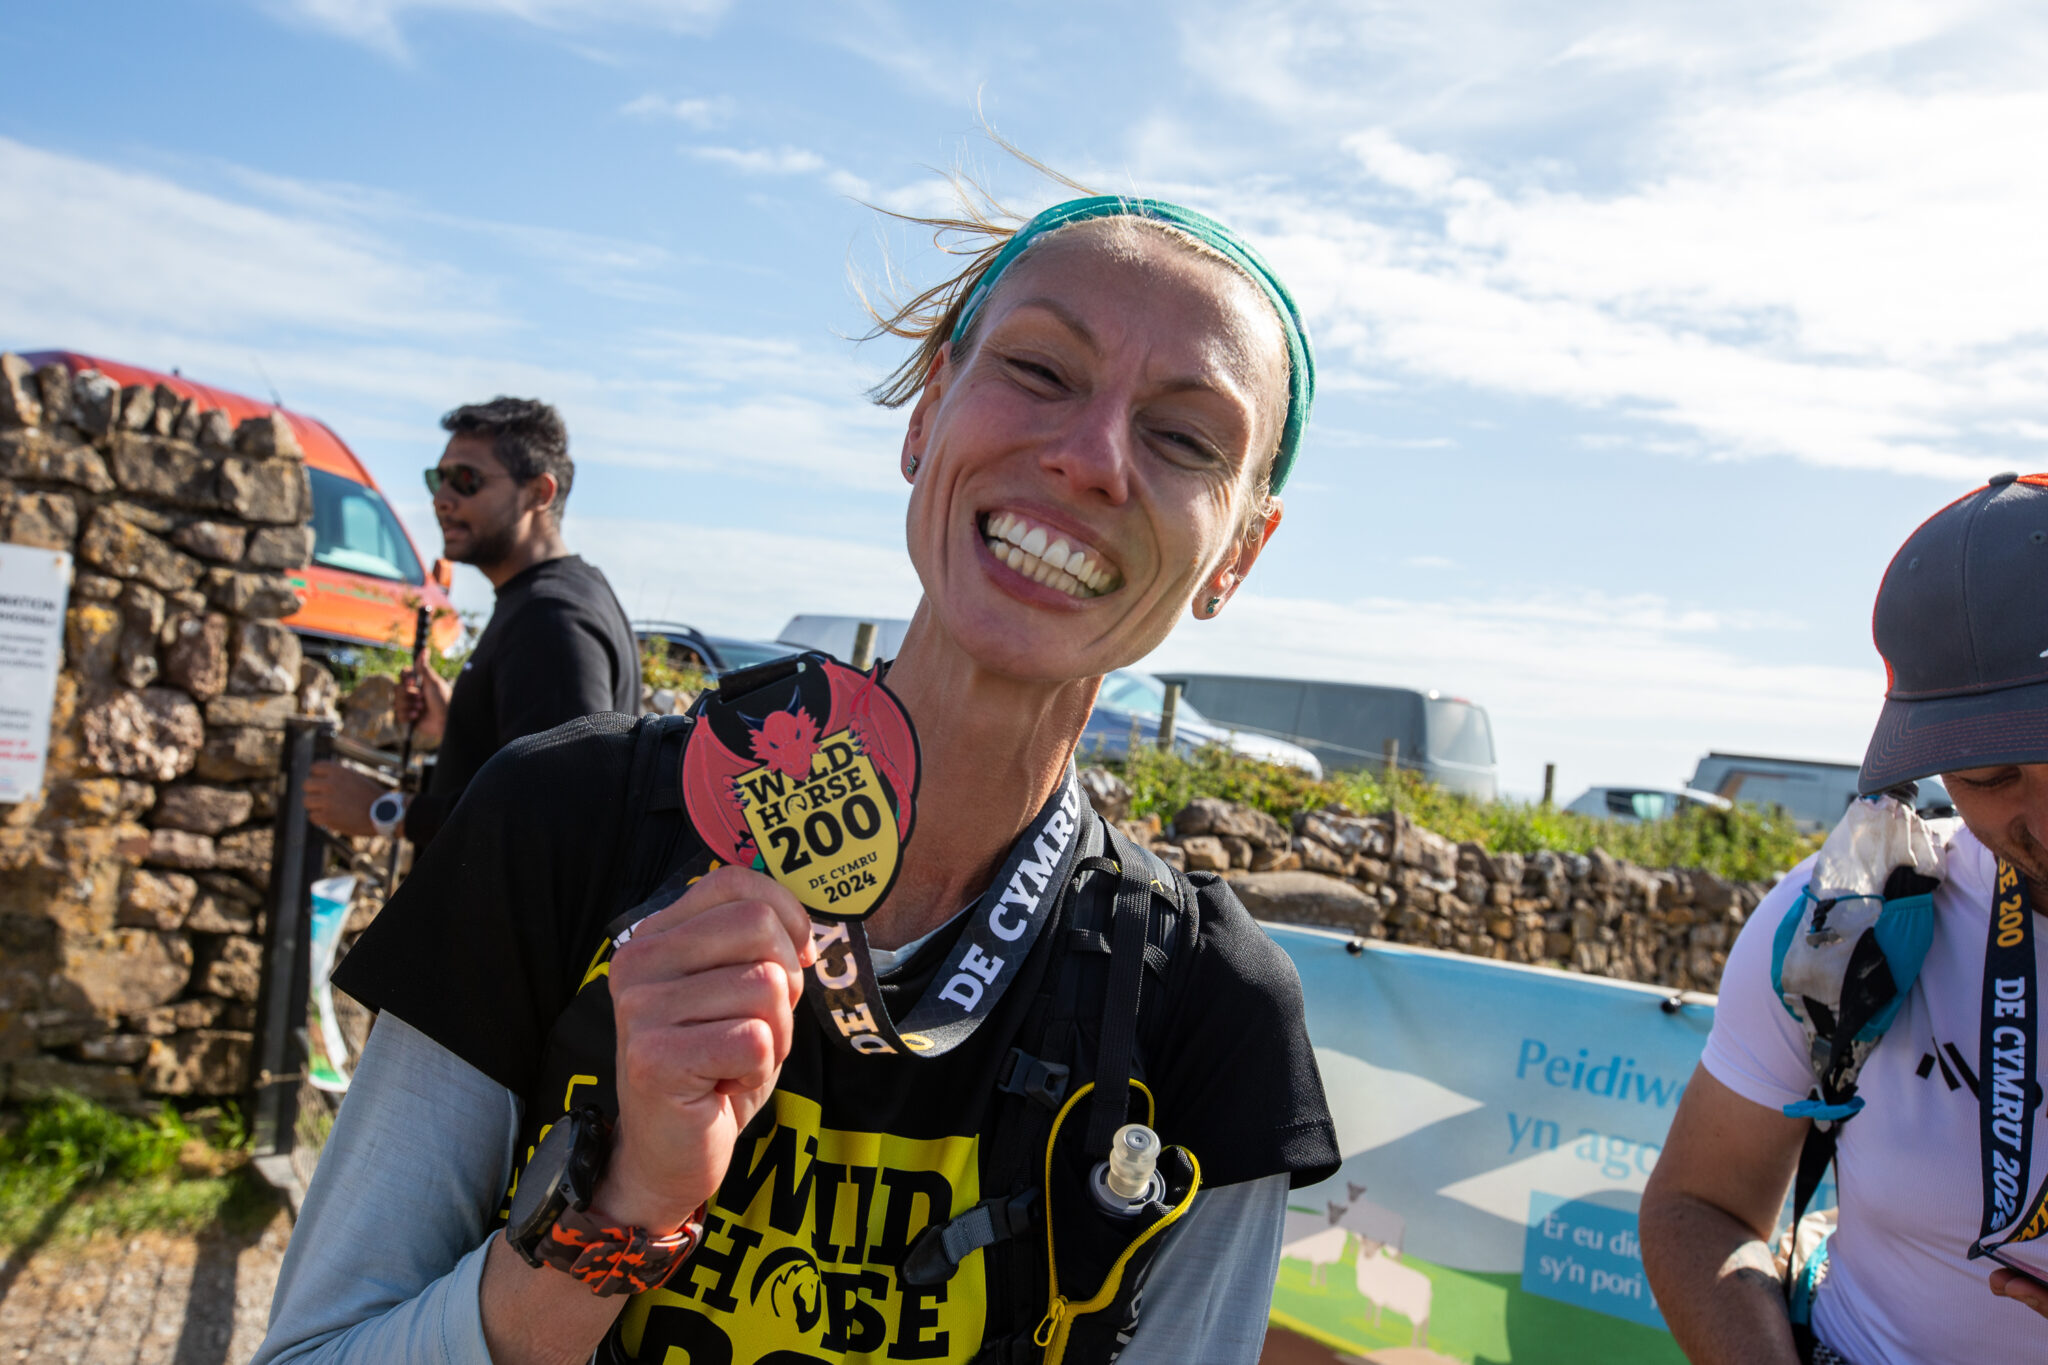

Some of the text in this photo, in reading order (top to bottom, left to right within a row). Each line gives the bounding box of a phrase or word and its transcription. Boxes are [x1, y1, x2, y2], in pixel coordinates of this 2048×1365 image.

[743, 741, 855, 806] WLD
[756, 766, 868, 831] HORSE
[768, 794, 881, 875] 200
[808, 851, 878, 890] DE CYMRU
[823, 870, 878, 905] 2024
[938, 774, 1080, 1013] DE CYMRU
[1996, 893, 2025, 948] 200
[1994, 976, 2026, 1018] DE
[830, 1002, 899, 1056] DE
[1992, 1026, 2026, 1152] CYMRU
[1506, 1111, 1561, 1154] yn
[1573, 1224, 1604, 1250] eu
[1538, 1254, 1643, 1299] sy'n pori
